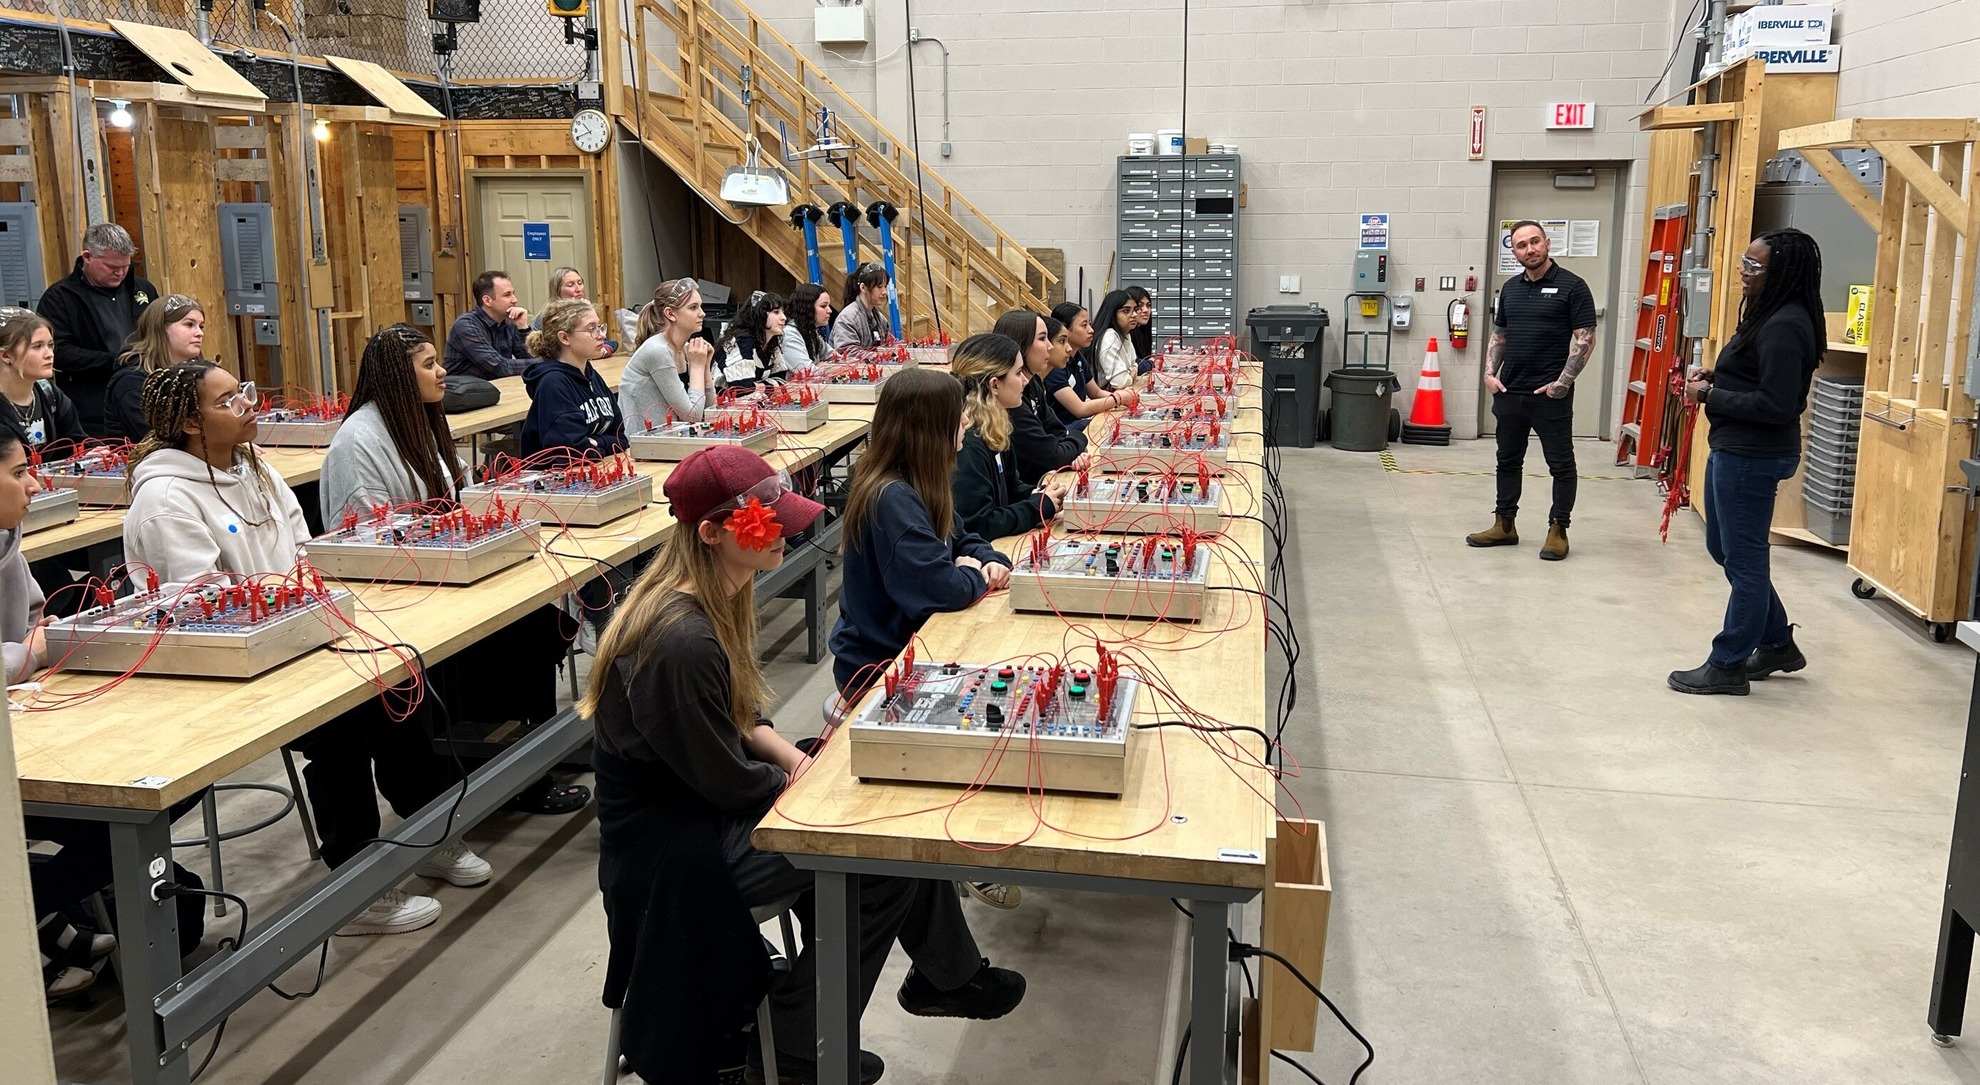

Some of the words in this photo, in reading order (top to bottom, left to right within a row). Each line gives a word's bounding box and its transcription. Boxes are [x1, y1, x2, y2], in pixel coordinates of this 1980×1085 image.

[1758, 20, 1804, 29] IBERVILLE
[1555, 104, 1586, 125] EXIT
[1656, 316, 1664, 346] LOUISVILLE
[1856, 302, 1866, 342] CLASSIC
